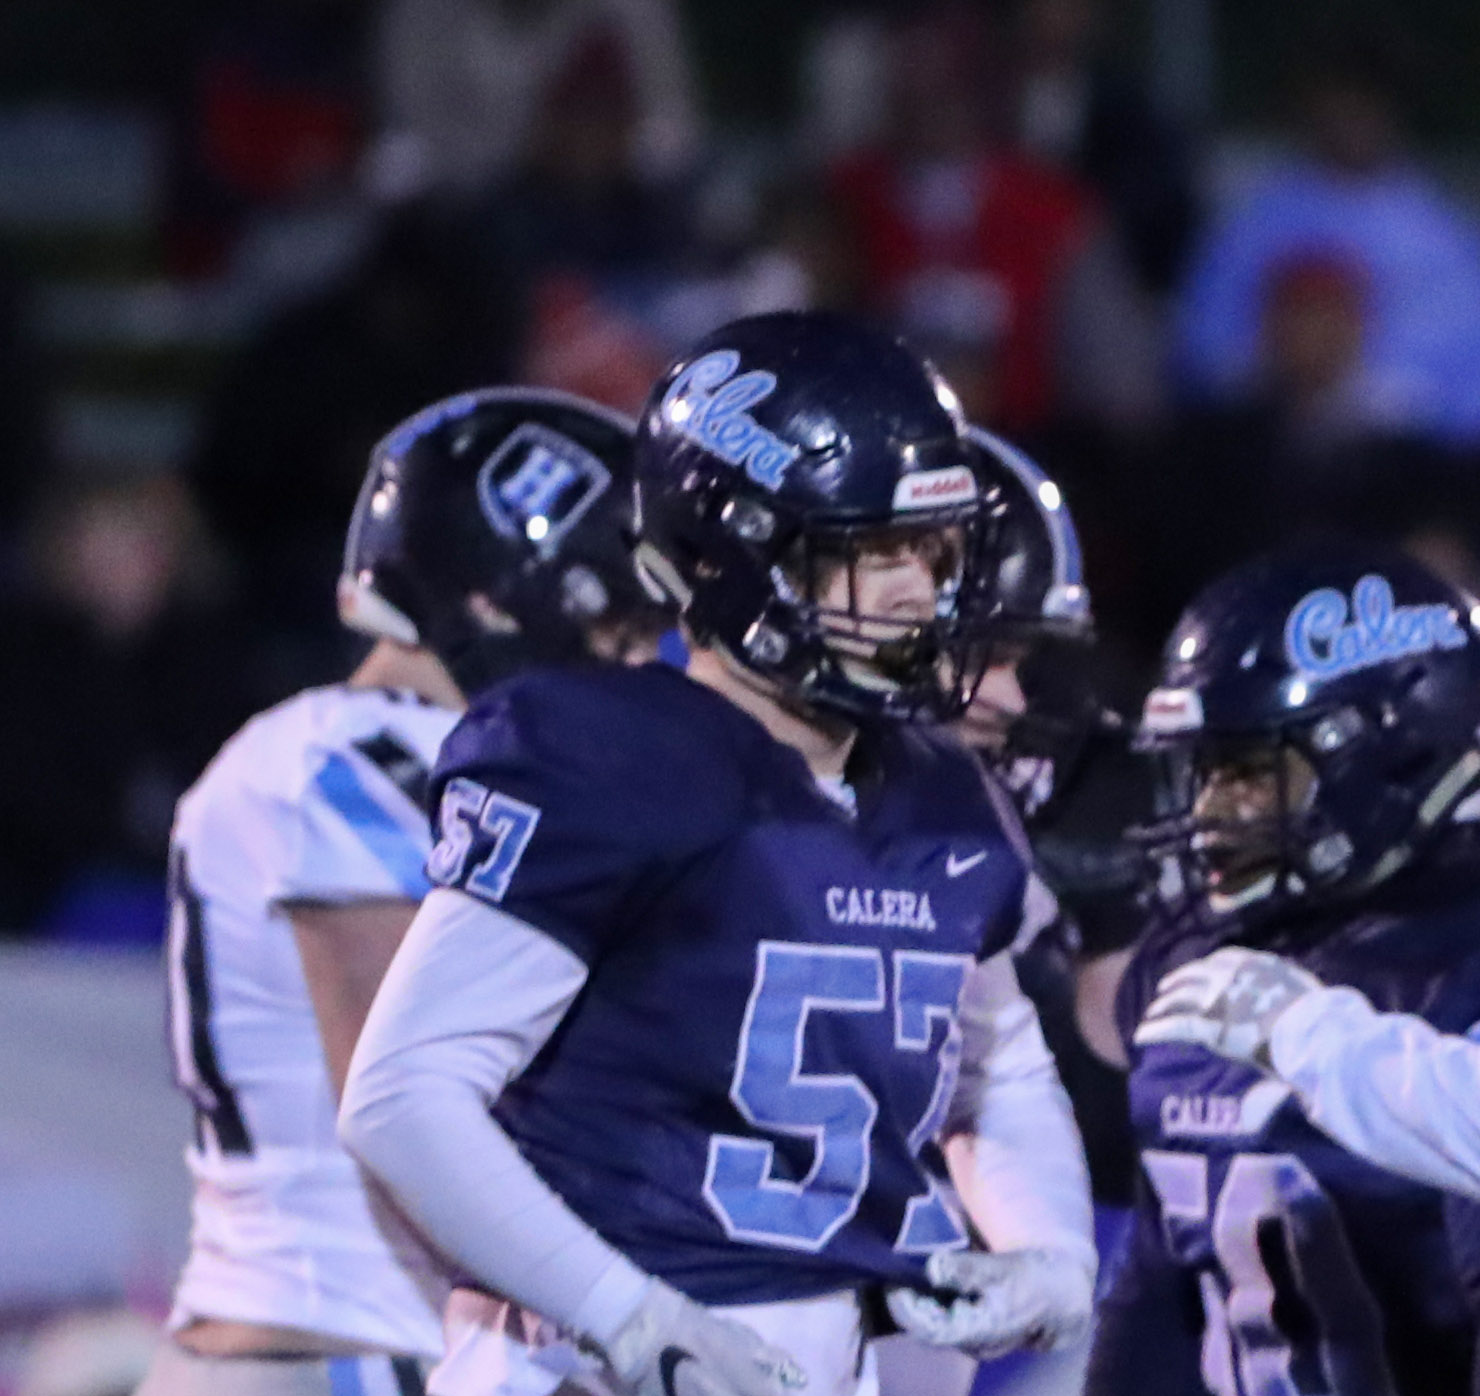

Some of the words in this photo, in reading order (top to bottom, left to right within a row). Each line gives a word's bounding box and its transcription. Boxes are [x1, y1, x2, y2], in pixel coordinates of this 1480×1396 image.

[423, 775, 541, 902] 57
[825, 886, 937, 933] CALERA
[702, 938, 973, 1254] 57
